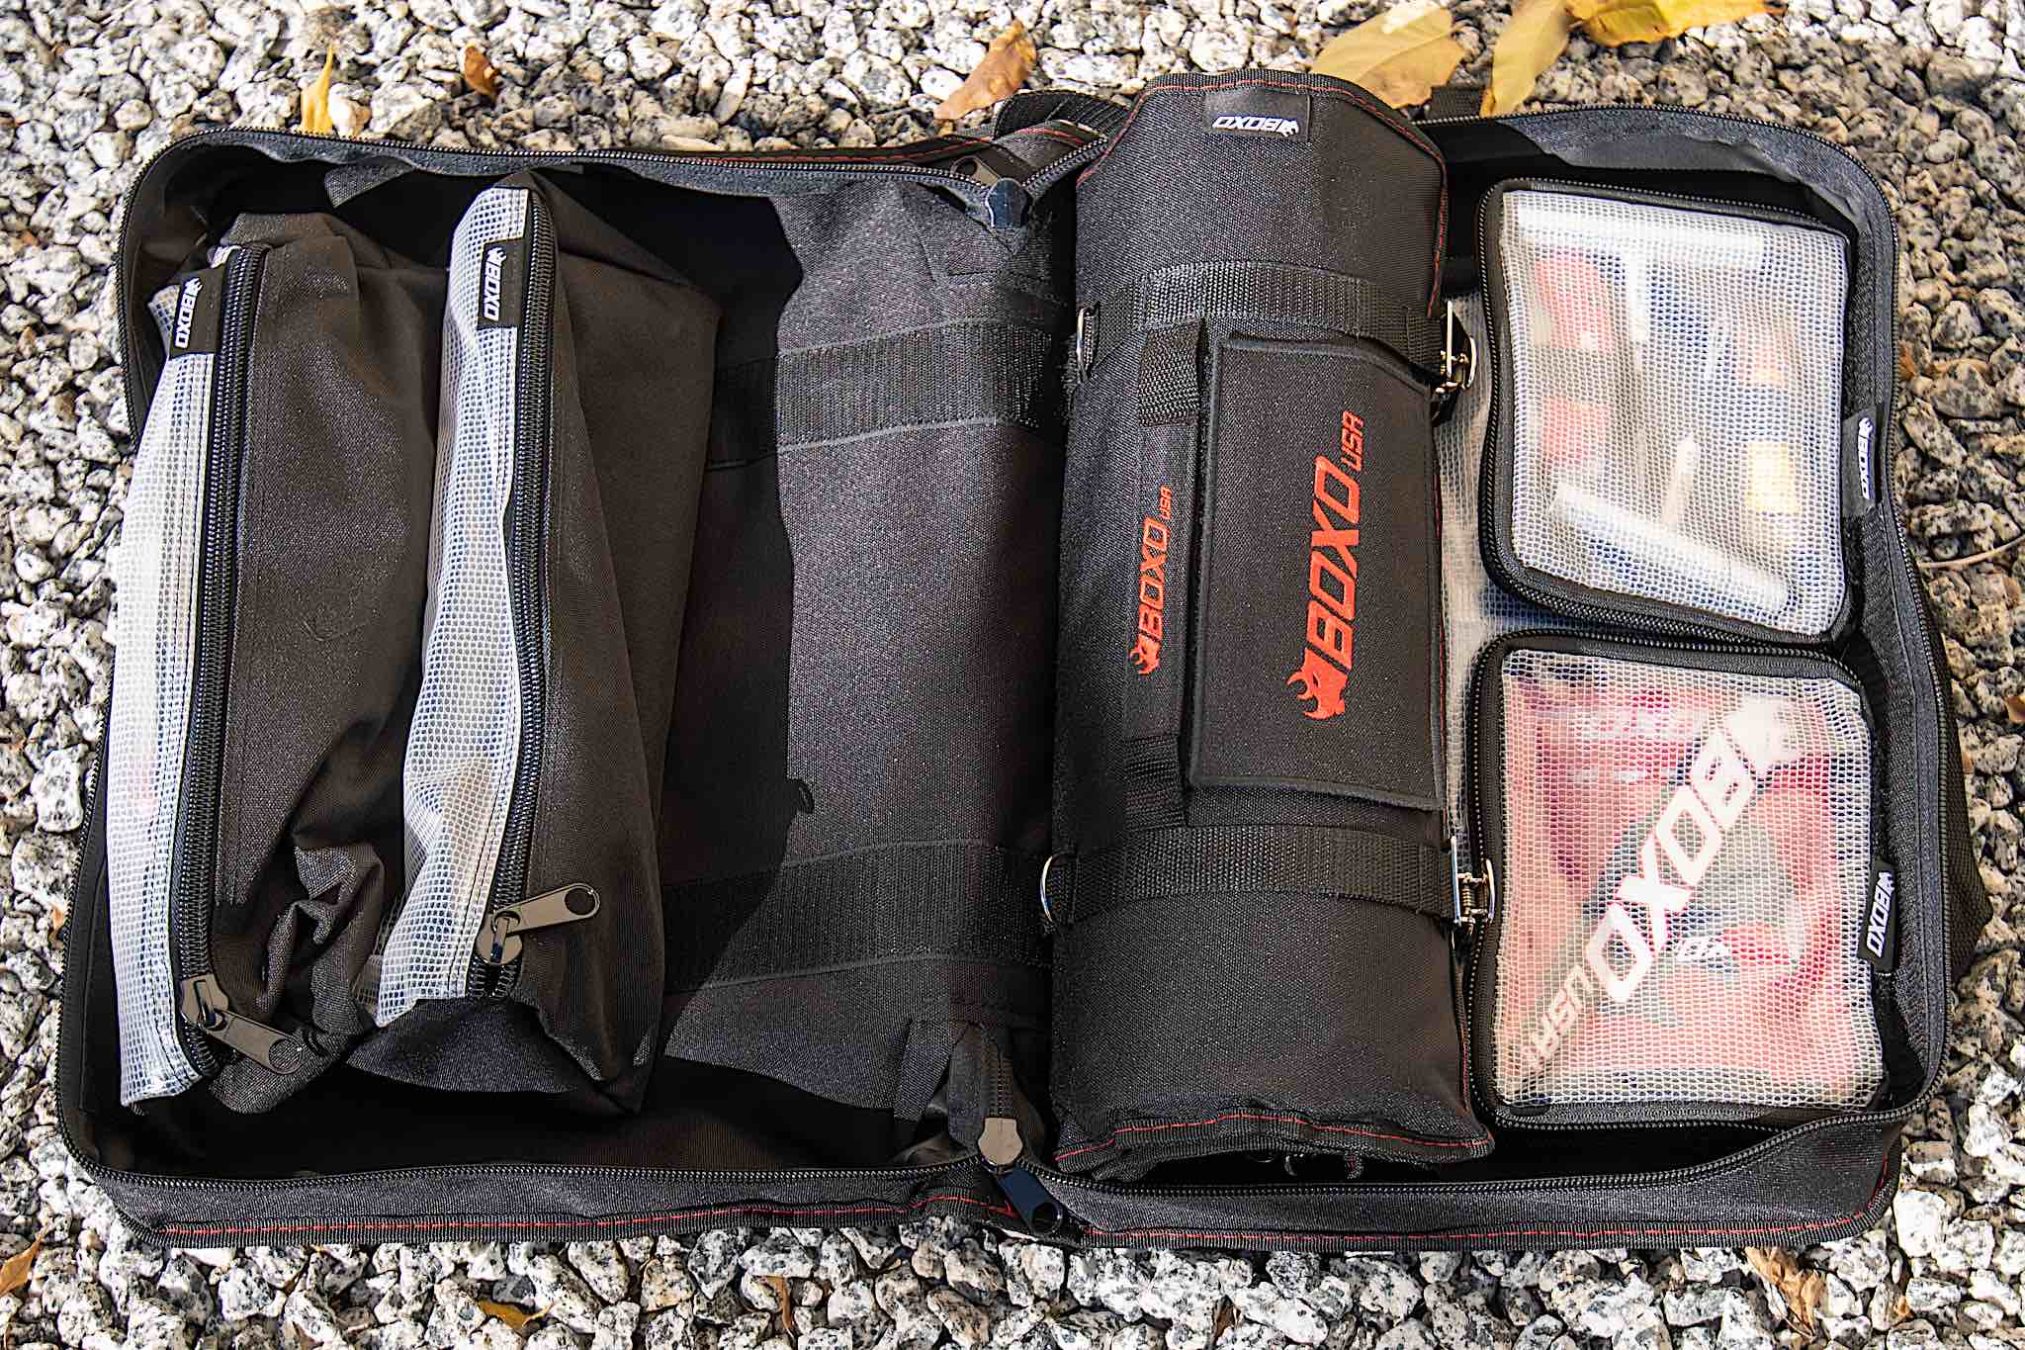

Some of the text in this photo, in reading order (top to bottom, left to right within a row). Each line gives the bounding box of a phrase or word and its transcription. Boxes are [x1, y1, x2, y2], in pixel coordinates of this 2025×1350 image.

[1212, 116, 1283, 133] BOXO
[174, 293, 197, 348] BOXO
[484, 261, 502, 321] BOXO
[1858, 435, 1870, 500] BOXO
[1138, 485, 1173, 640] BOXO USA
[1306, 410, 1365, 670] BOXO USA
[1585, 732, 1757, 1002] BOXO
[1866, 885, 1891, 958] BOXO
